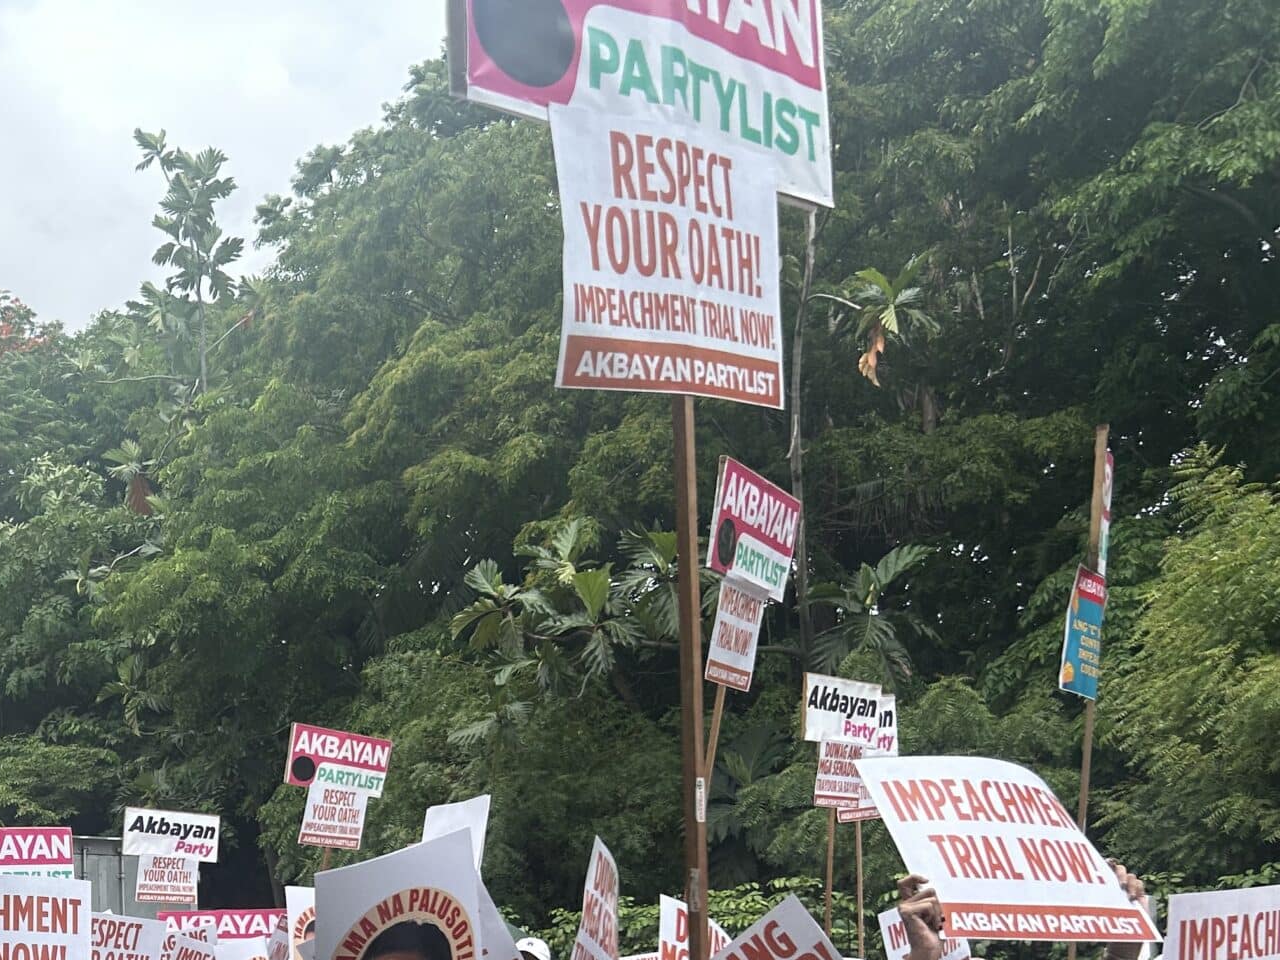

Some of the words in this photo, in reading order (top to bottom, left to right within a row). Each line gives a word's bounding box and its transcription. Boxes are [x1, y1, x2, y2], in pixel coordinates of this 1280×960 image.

[588, 27, 820, 162] PARTYLIST
[610, 131, 734, 220] RESPECT
[580, 202, 681, 279] YOUR
[688, 219, 763, 298] OATH!
[574, 284, 697, 334] IMPEACHMENT
[702, 300, 738, 343] TRIAL
[740, 309, 776, 350] NOW!
[575, 350, 692, 384] AKBAYAN
[694, 363, 775, 397] PARTYLIST
[724, 472, 798, 548] AKBAYAN
[736, 542, 787, 589] PARTYLIST
[808, 685, 877, 719] Akbayan
[295, 731, 389, 767] AKBAYAN
[844, 720, 876, 742] Party
[317, 767, 383, 791] PARTYLIST
[313, 804, 336, 821] YOUR
[323, 789, 356, 806] RESPECT
[881, 778, 1076, 831] IMPEACHMEN
[128, 815, 216, 840] Akbayan
[152, 857, 186, 870] RESPECT
[175, 841, 213, 857] Party
[927, 834, 1024, 881] TRIAL
[1017, 837, 1106, 886] NOW!
[144, 870, 165, 882] YOUR
[167, 871, 191, 884] OATH!
[376, 894, 404, 925] NA
[409, 888, 473, 960] PALUSOT!
[951, 911, 1044, 933] AKBAYAN
[1047, 914, 1143, 935] PARTYLIST
